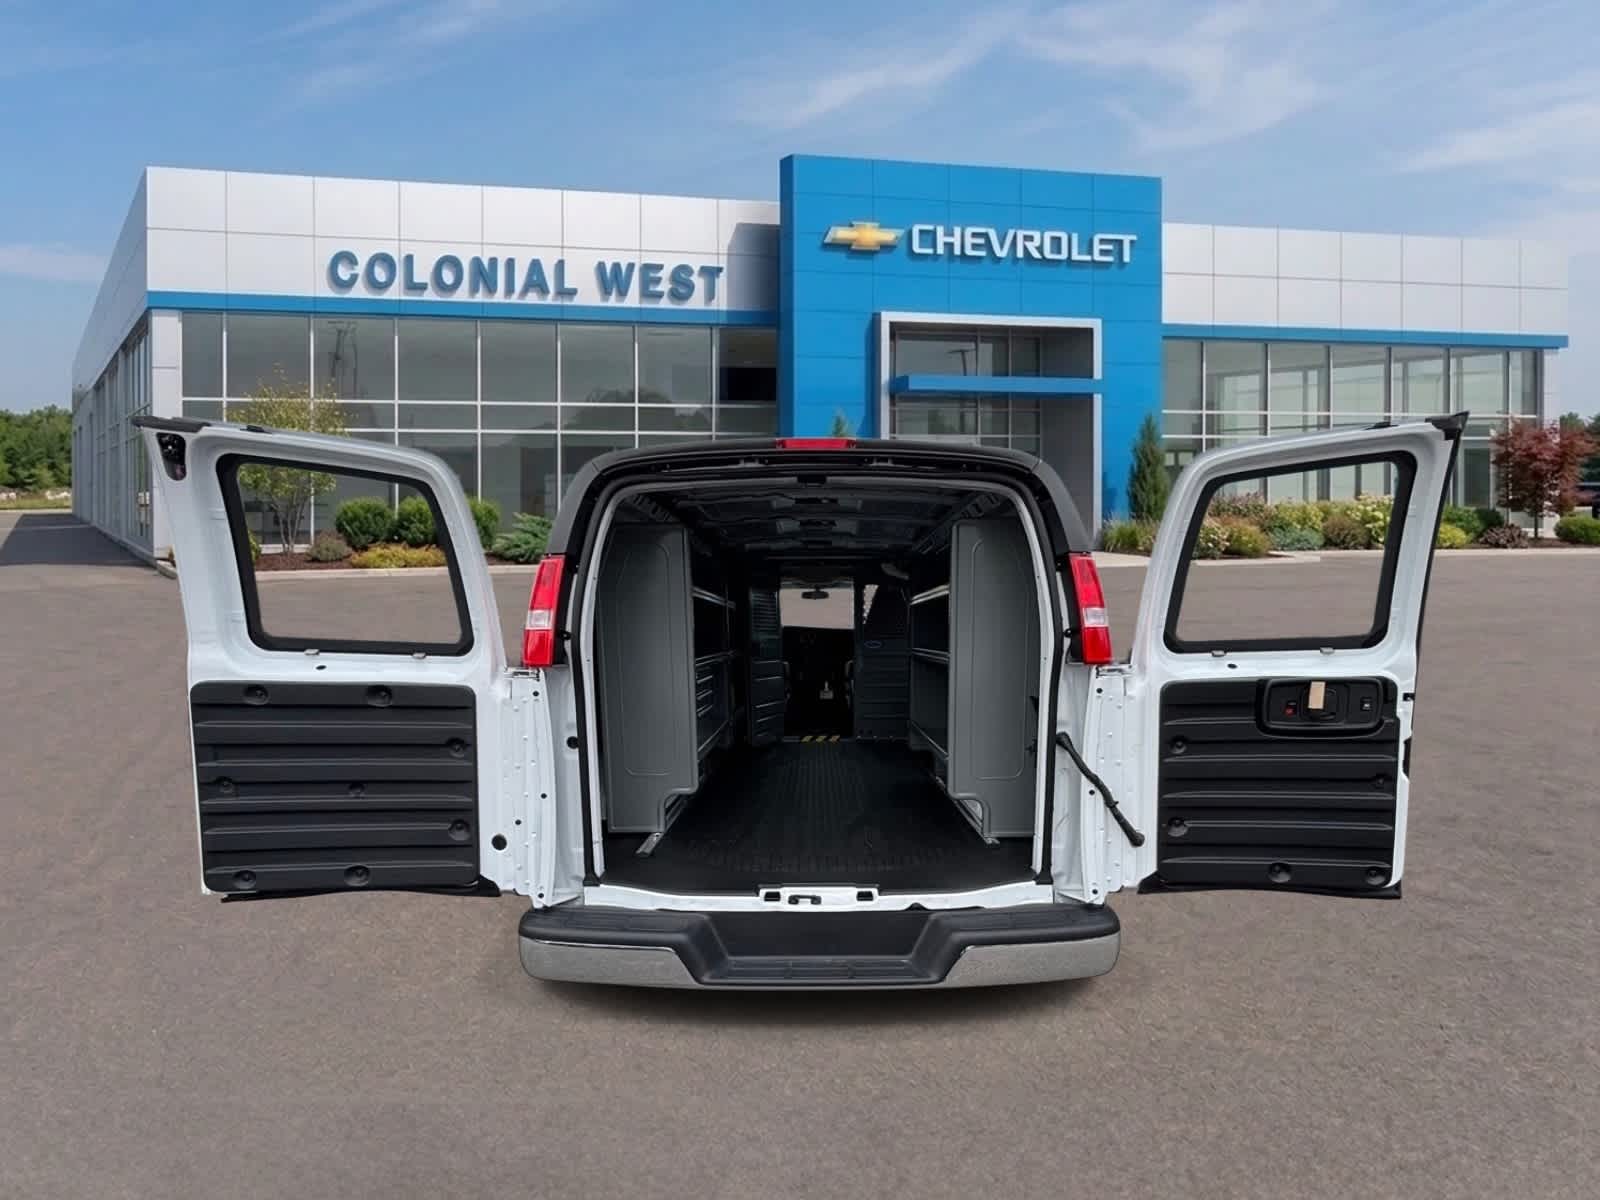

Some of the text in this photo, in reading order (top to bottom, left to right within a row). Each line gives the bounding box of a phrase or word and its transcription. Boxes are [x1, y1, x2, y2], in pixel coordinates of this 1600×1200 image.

[911, 223, 1138, 264] CHEVROLET
[326, 250, 724, 304] COLONIAL WEST
